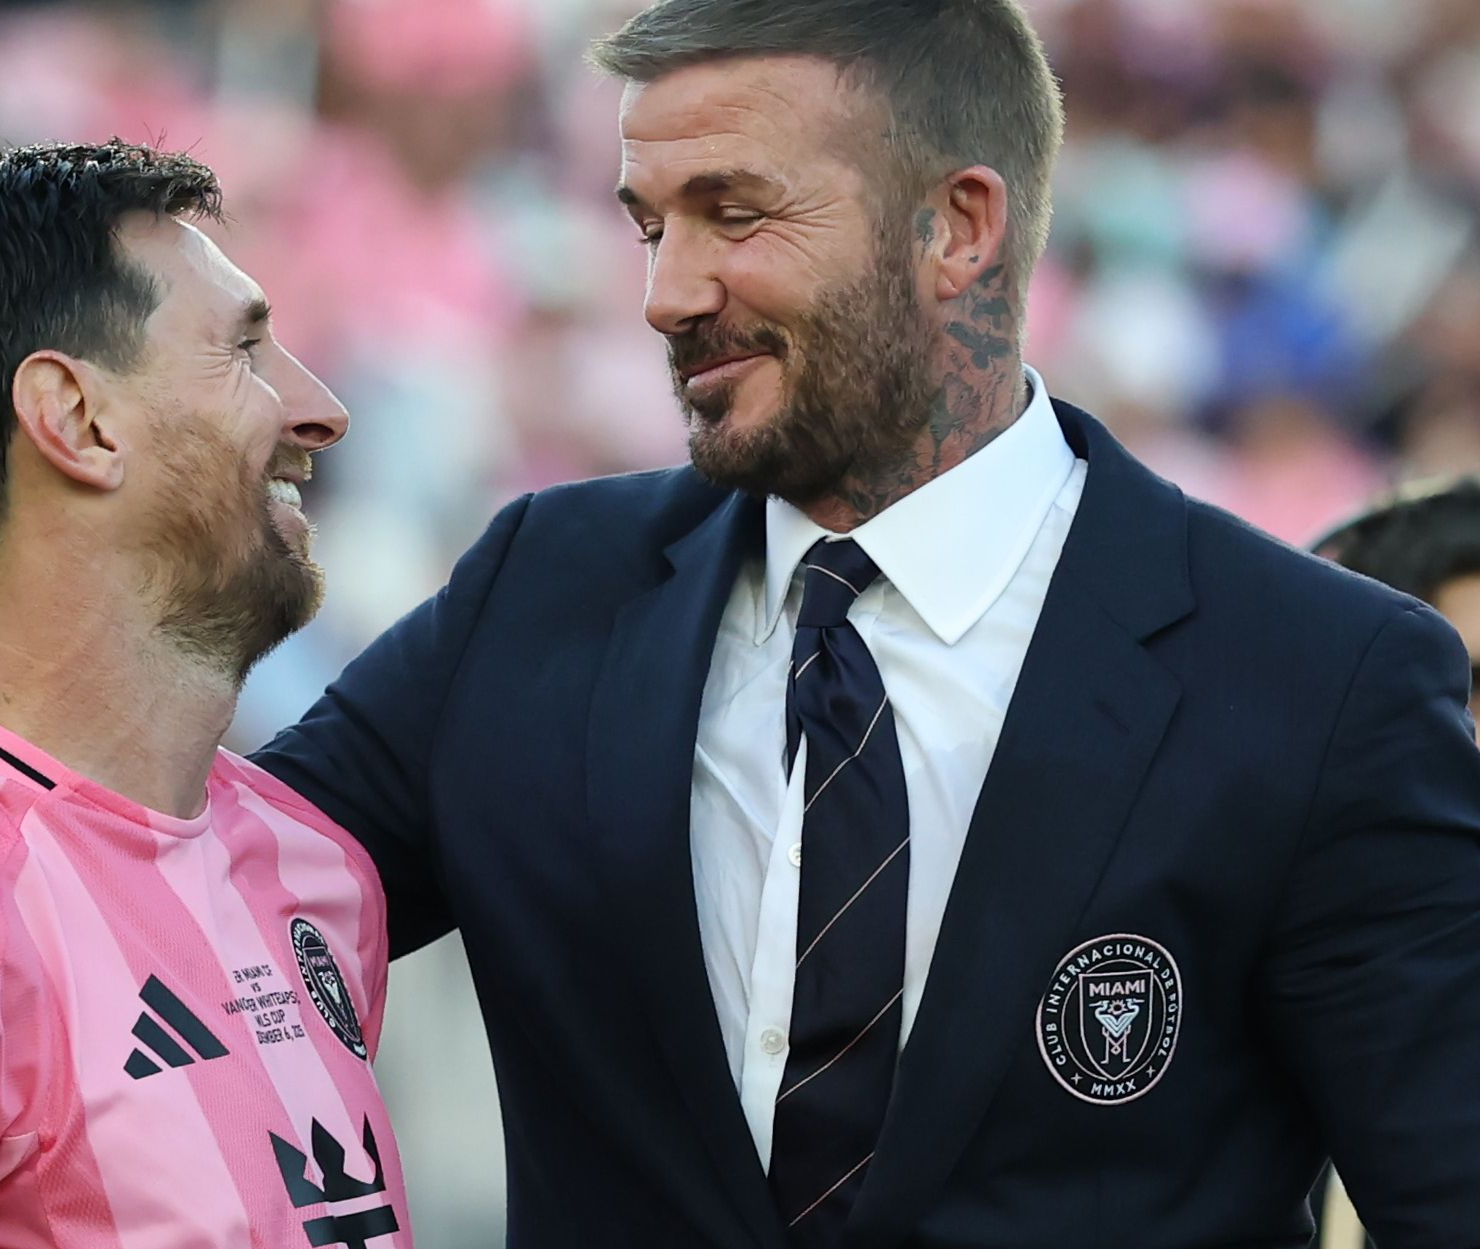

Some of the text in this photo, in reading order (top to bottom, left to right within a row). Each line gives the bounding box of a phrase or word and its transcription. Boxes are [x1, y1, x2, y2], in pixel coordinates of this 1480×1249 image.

[1046, 944, 1160, 1013] INTERNACIONAL
[1089, 979, 1146, 997] MIAMI
[1161, 968, 1175, 990] DE
[1046, 1023, 1067, 1066] CLUB
[1090, 1078, 1137, 1097] MMXX
